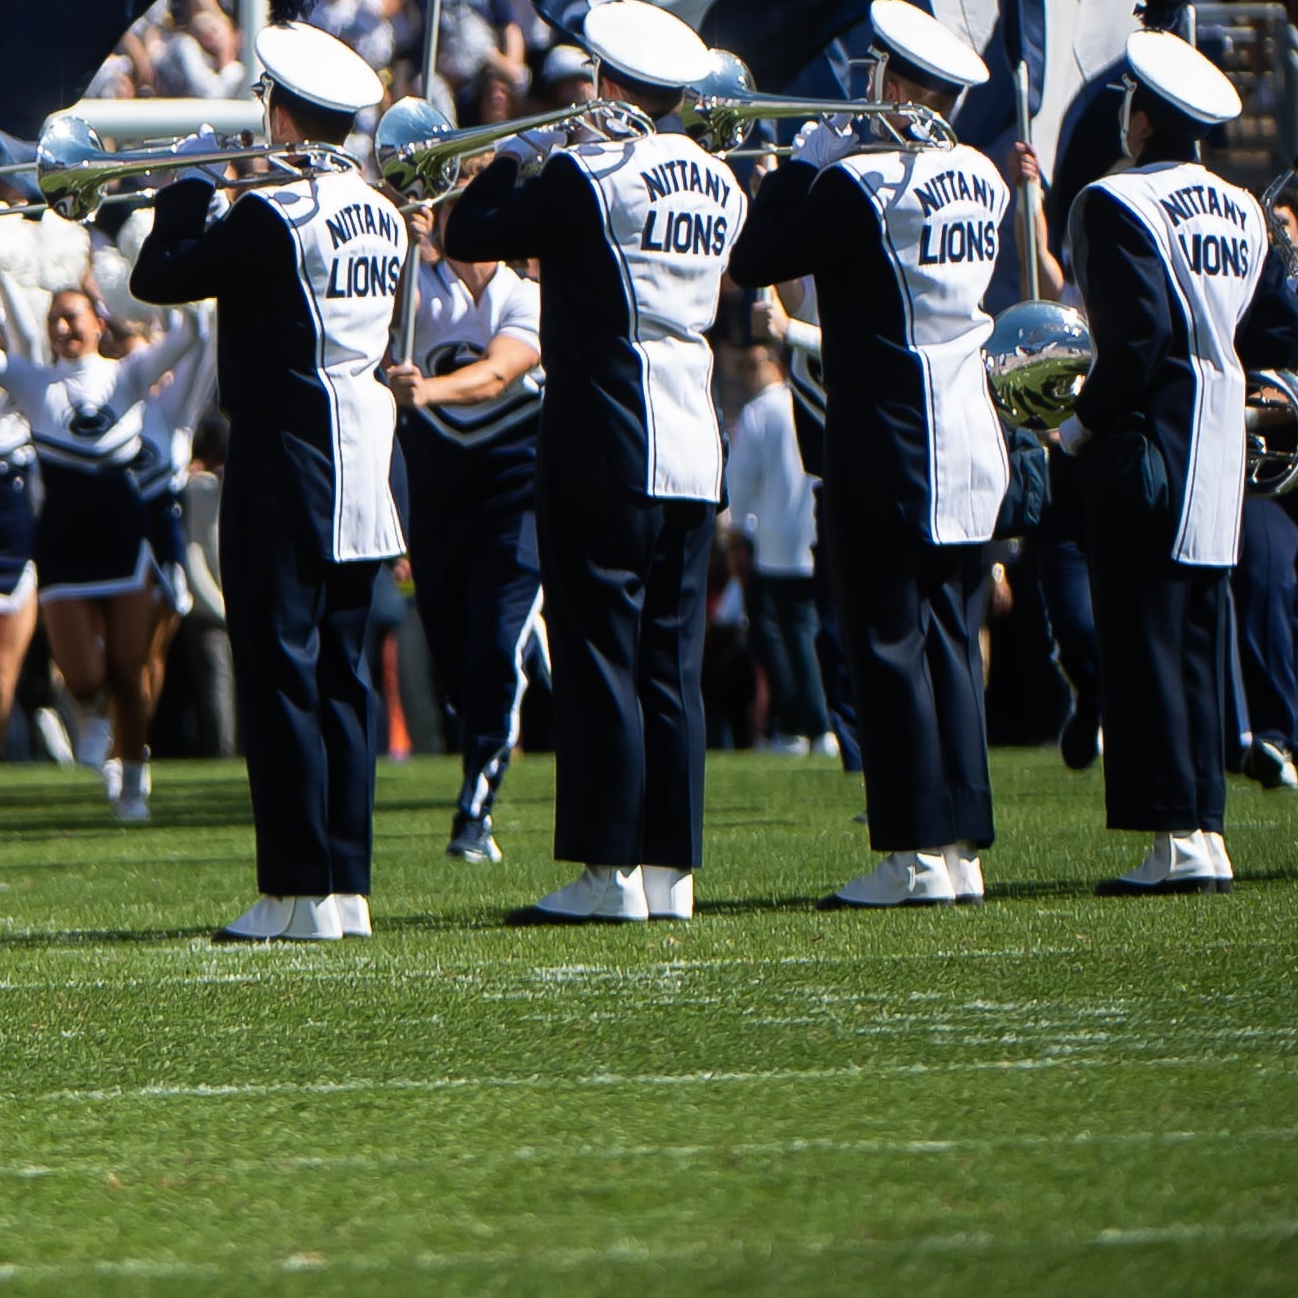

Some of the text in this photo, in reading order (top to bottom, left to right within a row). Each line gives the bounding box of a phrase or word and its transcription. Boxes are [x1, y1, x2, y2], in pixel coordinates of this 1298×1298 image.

[640, 159, 731, 209] NITTANY
[913, 169, 995, 219] NITTANY
[325, 203, 399, 251] NITTANY
[1159, 185, 1247, 232] NITTANY
[640, 209, 728, 257] LIONS
[918, 220, 996, 266] LIONS
[1177, 233, 1249, 280] LIONS
[325, 255, 401, 299] LIONS
